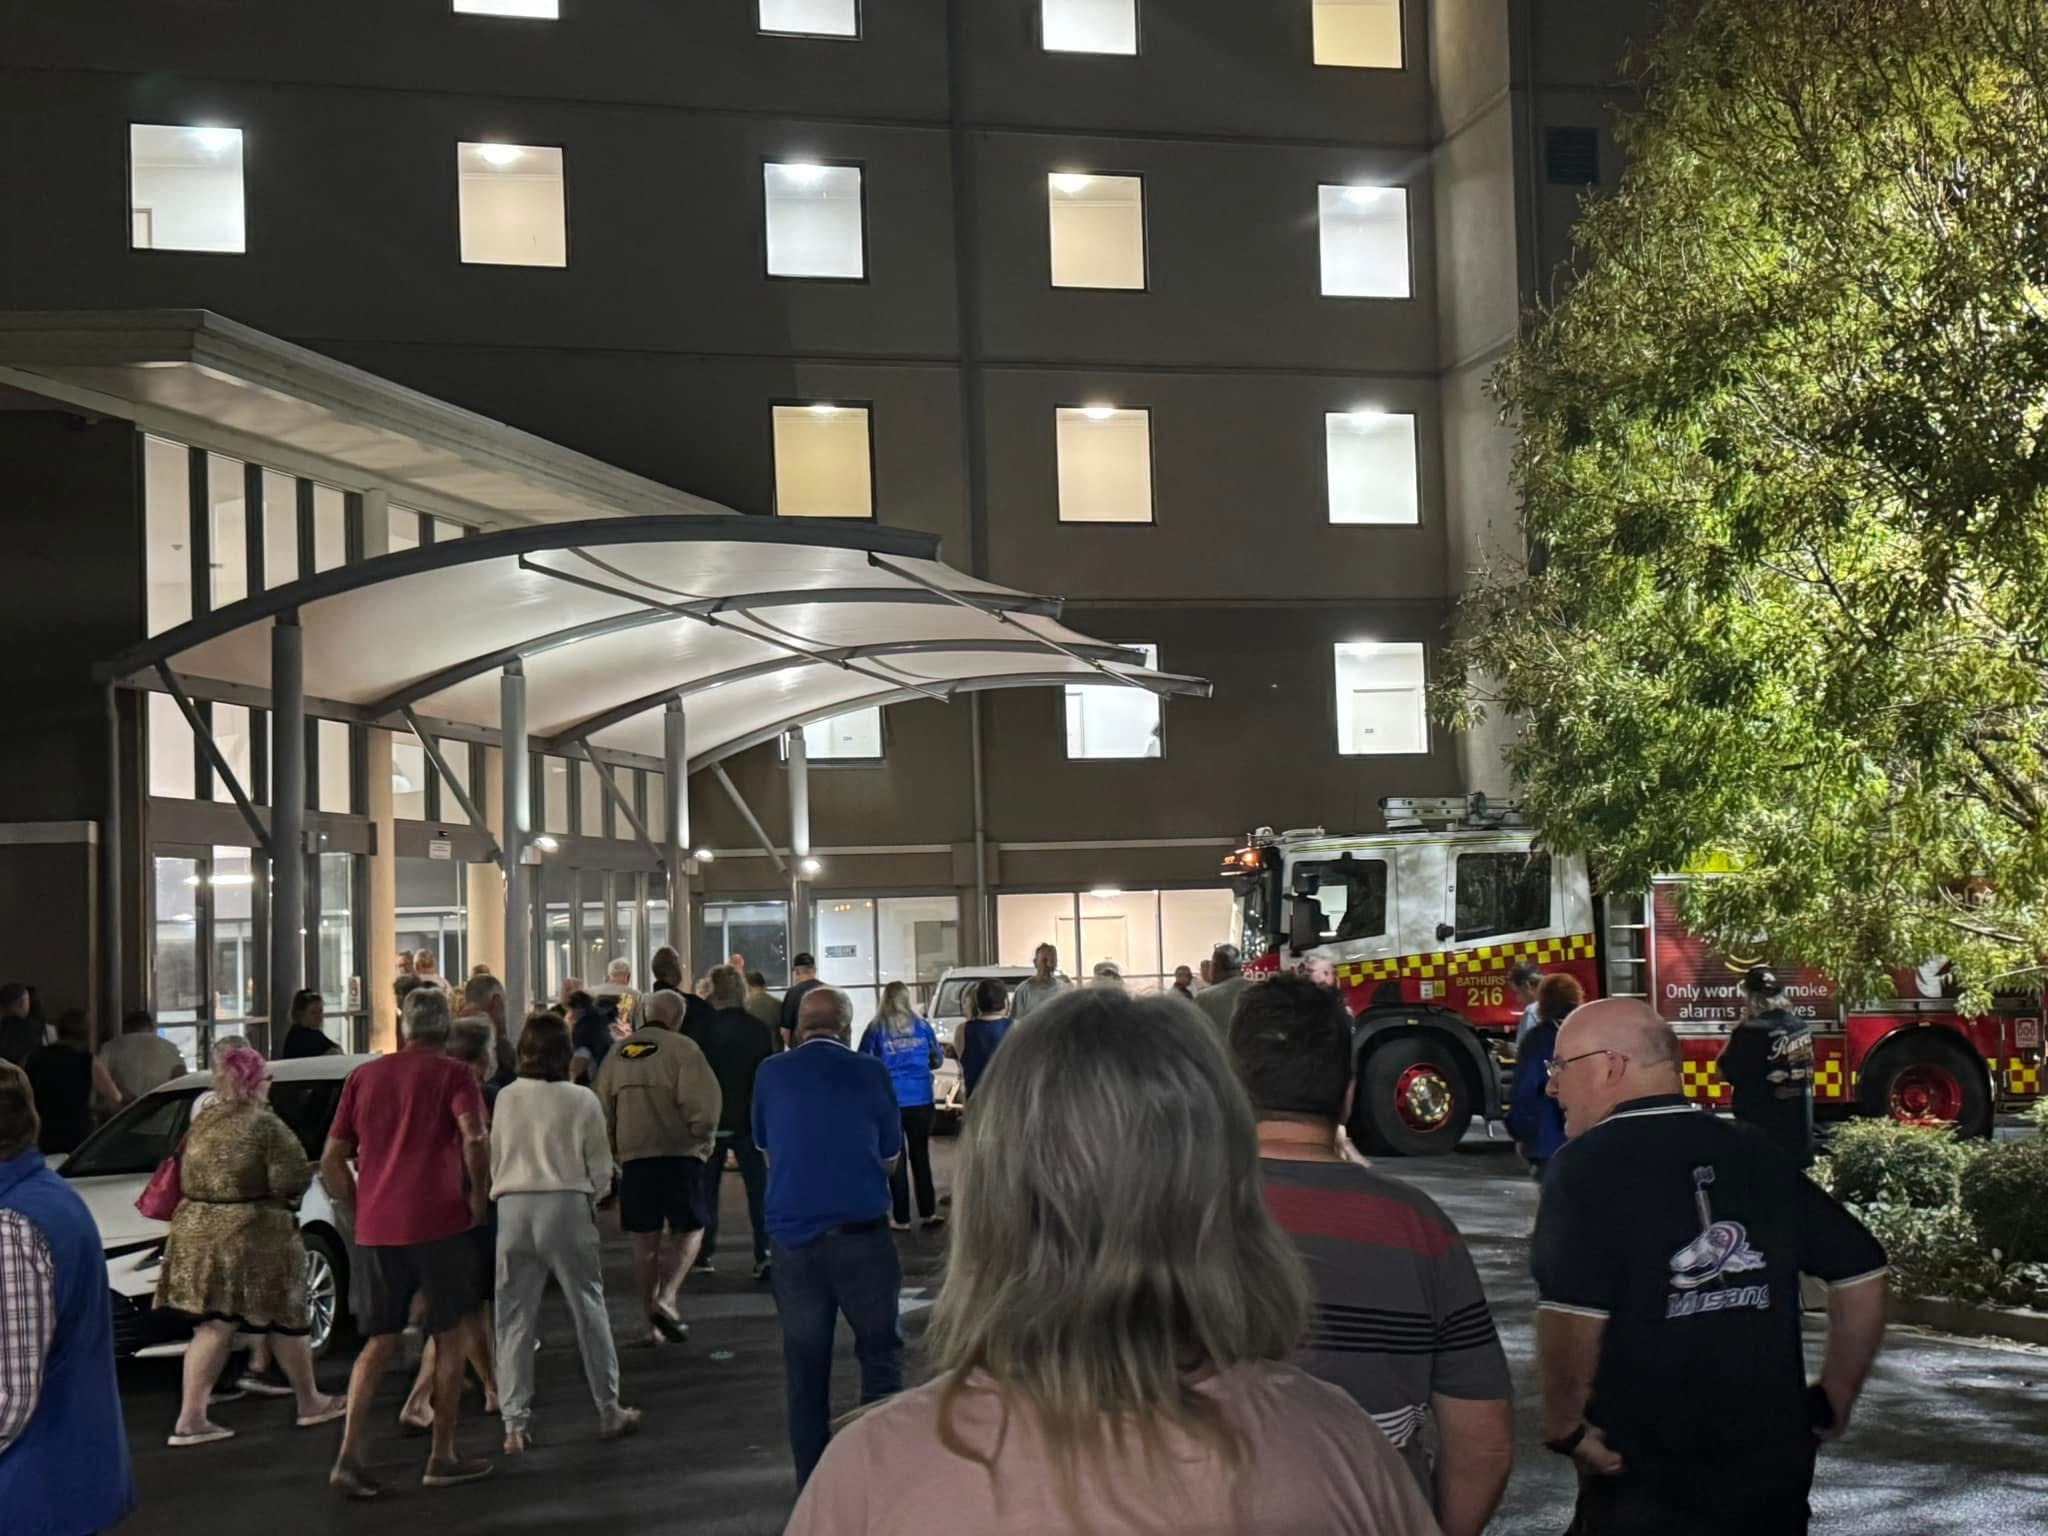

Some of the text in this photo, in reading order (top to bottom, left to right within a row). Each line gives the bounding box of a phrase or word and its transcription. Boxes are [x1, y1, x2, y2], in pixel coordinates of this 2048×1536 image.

[1467, 987, 1504, 1007] 216
[1666, 980, 1828, 1001] Only work moke
[1679, 1003, 1736, 1018] alarms
